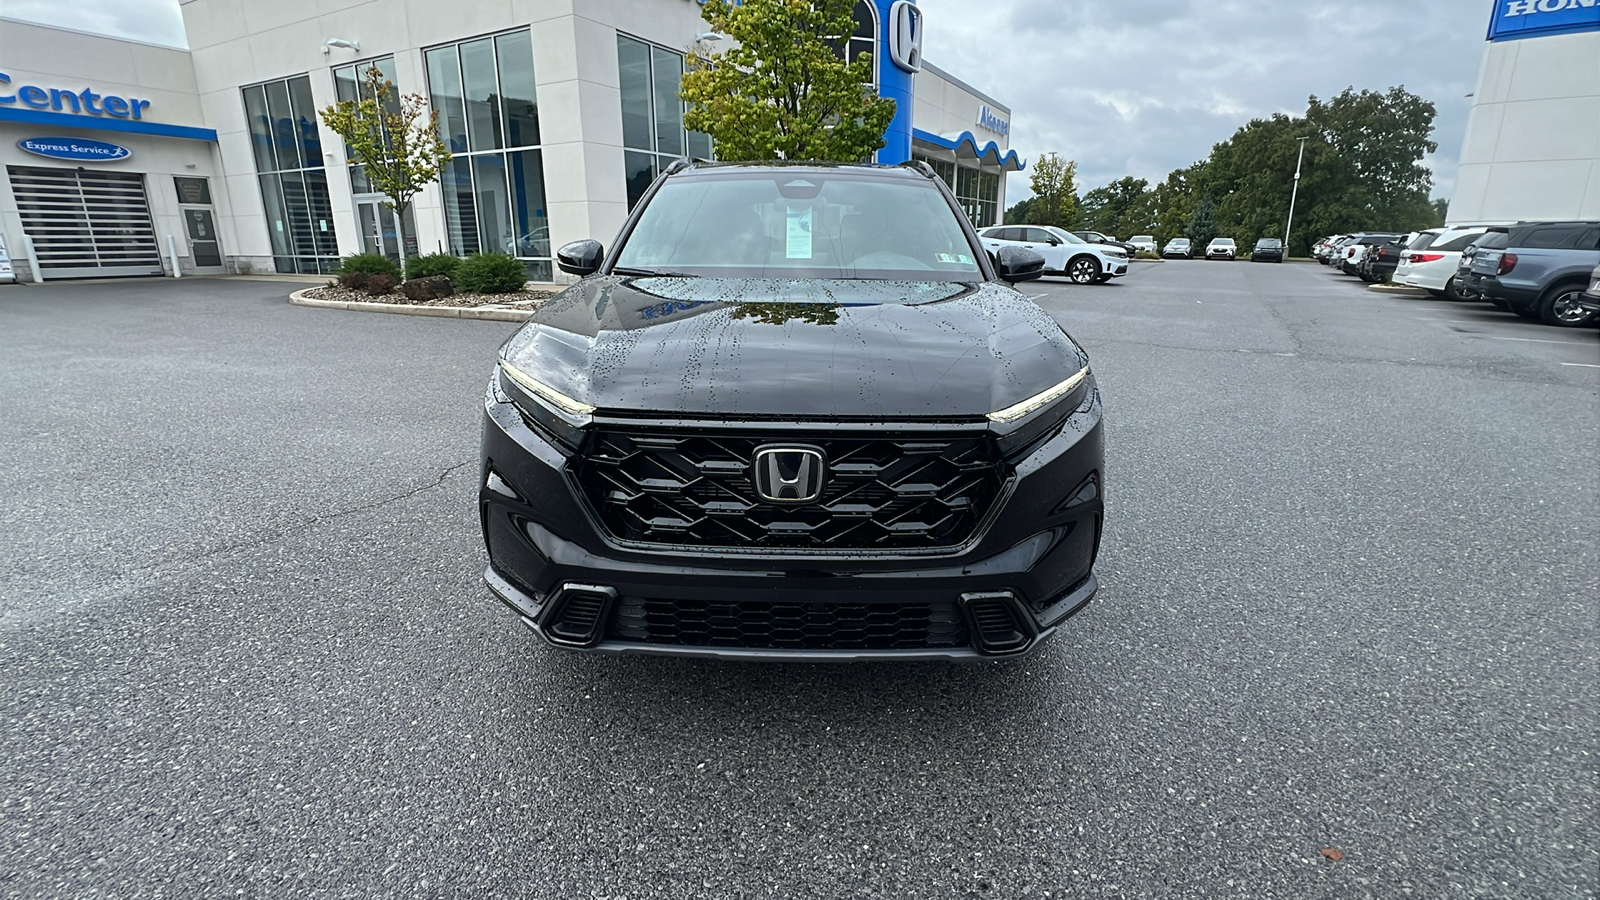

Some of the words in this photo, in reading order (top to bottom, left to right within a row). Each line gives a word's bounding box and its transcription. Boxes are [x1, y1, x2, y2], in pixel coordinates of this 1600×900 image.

[1504, 0, 1600, 17] HON
[25, 141, 69, 152] Express
[70, 144, 110, 155] Service
